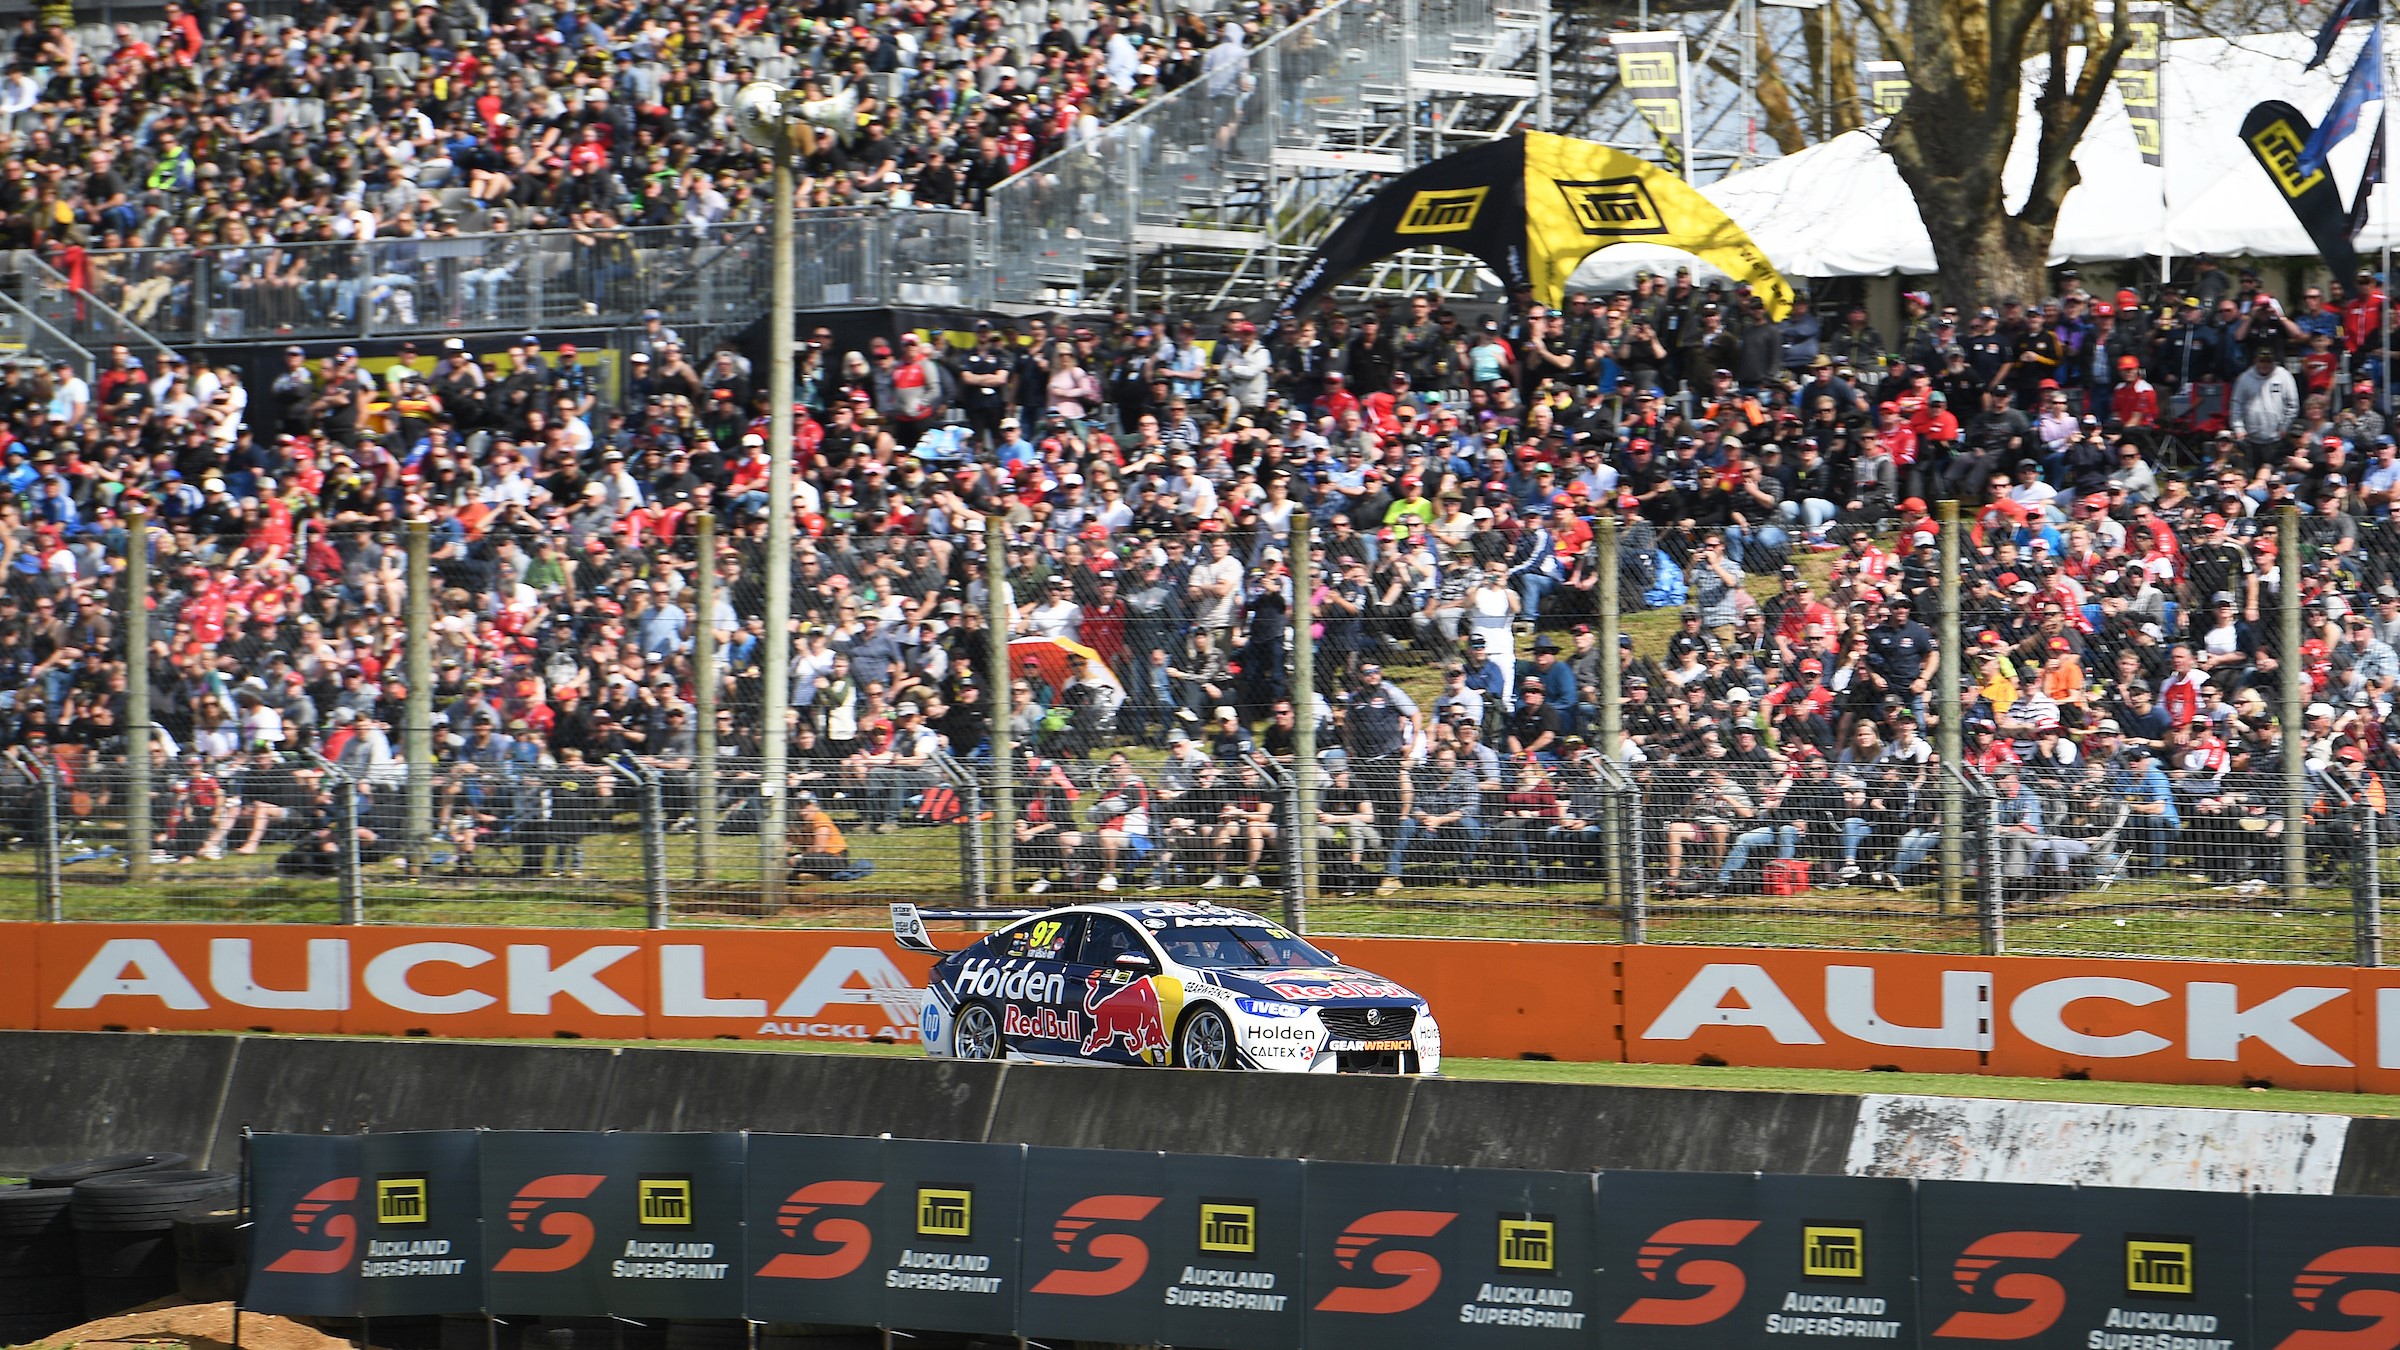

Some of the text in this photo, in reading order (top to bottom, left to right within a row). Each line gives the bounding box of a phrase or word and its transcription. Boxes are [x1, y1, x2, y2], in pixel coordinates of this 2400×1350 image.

[1030, 921, 1062, 947] 97
[54, 938, 922, 1026] AUCKLA
[1184, 981, 1234, 1001] GEARWRENCH
[1252, 1001, 1301, 1017] IVECO
[1641, 963, 2400, 1070] AUCK
[757, 1021, 921, 1040] AUCKLAN
[924, 1004, 940, 1041] hp
[1248, 1025, 1315, 1040] Holden
[1250, 1046, 1296, 1058] CALTEX
[1329, 1040, 1412, 1052] GEARWRENCH
[380, 1183, 424, 1220] itm
[642, 1184, 688, 1221] itm
[920, 1193, 968, 1232] itm
[1203, 1208, 1251, 1248] itm
[367, 1239, 451, 1257] AUCKLAND
[624, 1239, 715, 1259] AUCKLAND
[1502, 1224, 1550, 1265] itm
[1807, 1231, 1858, 1273] itm
[360, 1258, 467, 1278] SUPERSPRINT
[612, 1259, 730, 1280] SUPERSPRINT
[898, 1249, 990, 1272] AUCKLAND
[2130, 1246, 2188, 1289] itm
[885, 1269, 1003, 1294] SUPERSPRINT
[1179, 1265, 1276, 1289] AUCKLAND
[1164, 1286, 1288, 1312] SUPERSPRINT
[1476, 1282, 1573, 1307] AUCKLAND
[1781, 1291, 1886, 1315] AUCKLAND
[1458, 1303, 1586, 1330] SUPERSPRINT
[1765, 1314, 1901, 1339] SUPERSPRINT
[2104, 1307, 2218, 1333] AUCKLAND
